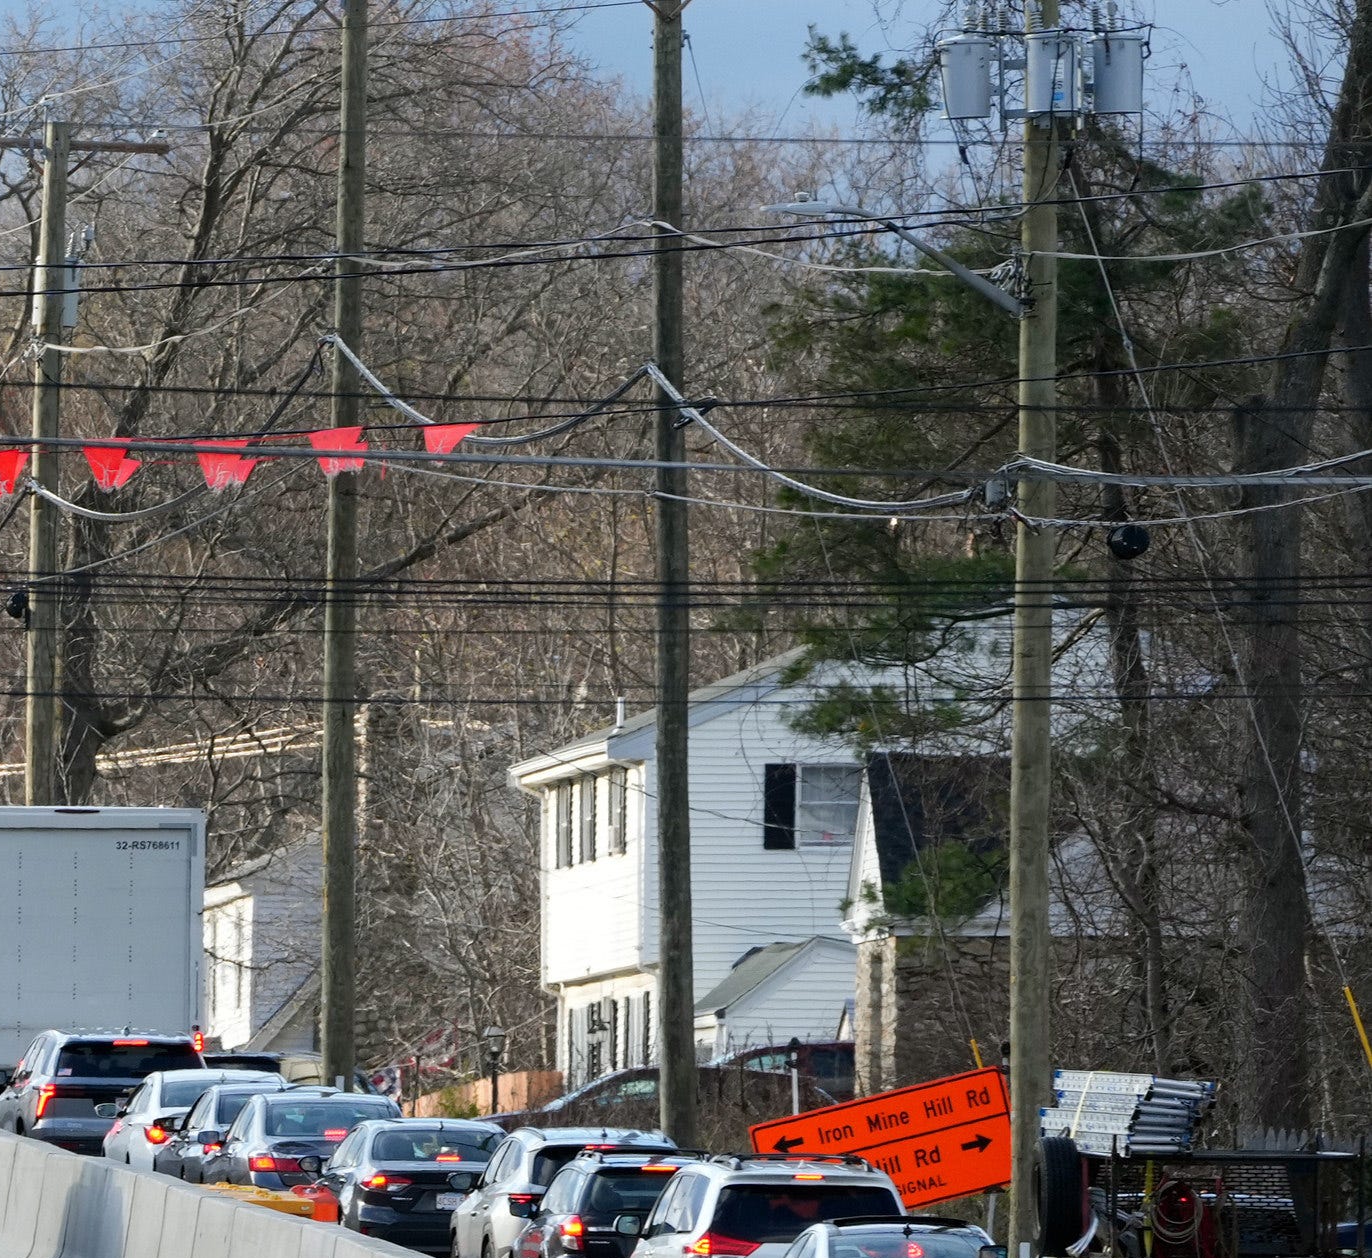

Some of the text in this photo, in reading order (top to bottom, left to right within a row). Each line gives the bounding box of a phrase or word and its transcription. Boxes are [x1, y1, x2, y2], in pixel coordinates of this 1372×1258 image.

[817, 1086, 992, 1145] Iron Mine Hill Rd
[913, 1144, 942, 1168] Rd
